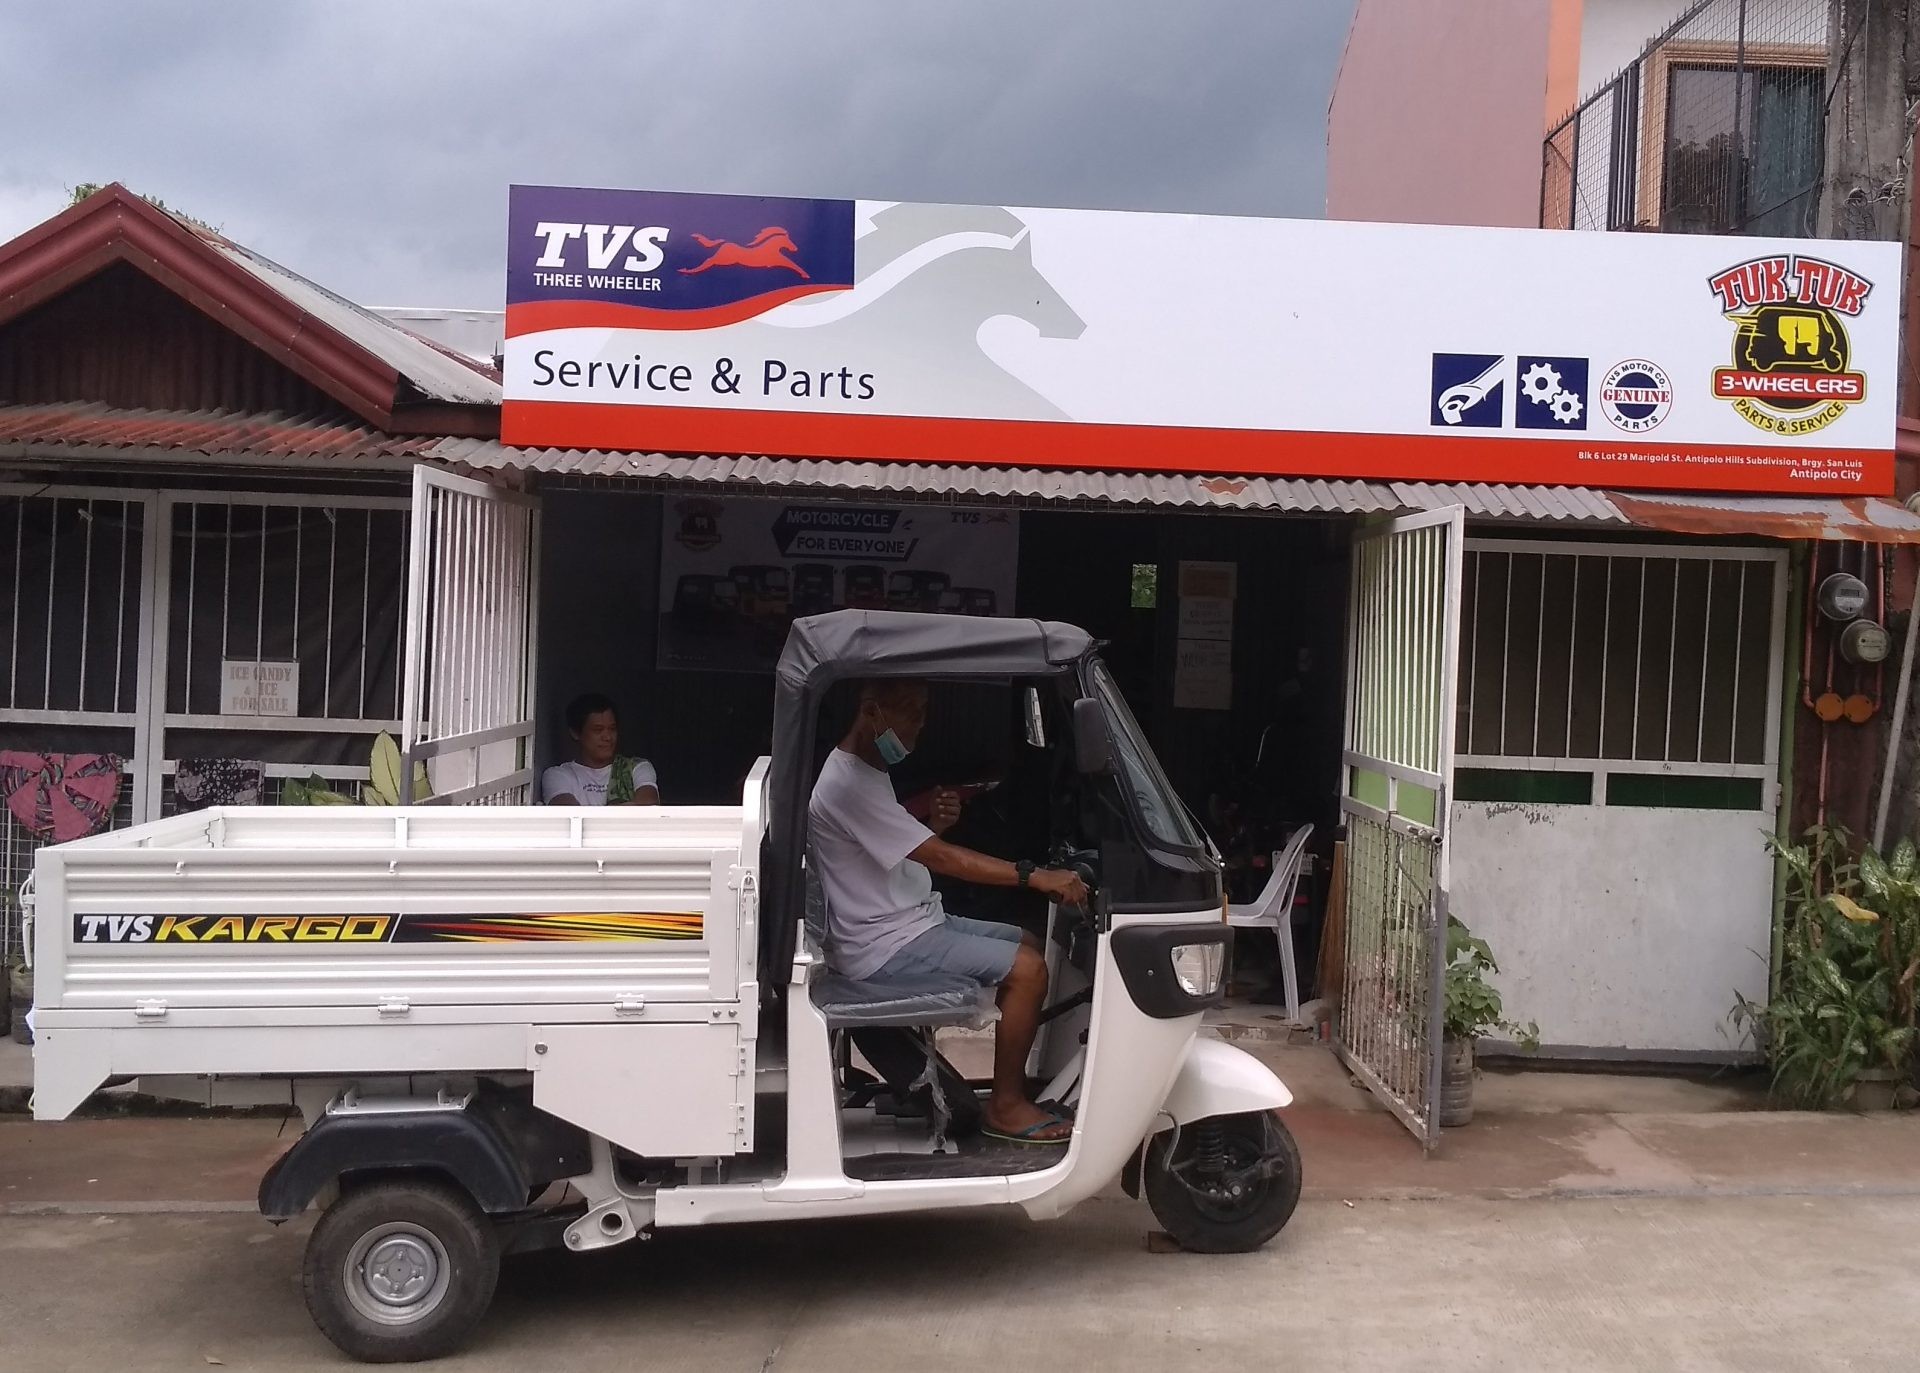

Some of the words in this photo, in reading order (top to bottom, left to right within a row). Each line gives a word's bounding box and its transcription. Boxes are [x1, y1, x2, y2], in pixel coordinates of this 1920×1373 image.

[533, 221, 670, 272] TVS
[533, 272, 583, 288] THREE
[587, 275, 662, 291] WHEELER
[1712, 258, 1787, 308] TUK
[1795, 259, 1869, 313] TUK
[533, 350, 692, 391] Service
[710, 357, 741, 394] &
[762, 359, 875, 400] Parts
[1606, 370, 1621, 386] TVS
[1621, 363, 1654, 374] MOTOR
[1654, 372, 1666, 388] CO.
[1721, 375, 1858, 394] 3-WHEELERS
[1603, 389, 1670, 403] GENUINE
[1614, 415, 1658, 429] PARTS
[1736, 398, 1774, 429] PARTS
[1776, 420, 1787, 433] &
[1790, 401, 1844, 433] SERVICE
[1578, 451, 1592, 460] Blk
[1593, 452, 1600, 460] 6
[1601, 452, 1616, 461] Lot
[1617, 452, 1628, 461] 29
[1629, 453, 1670, 464] Marigold
[1671, 455, 1683, 463] St.
[1685, 455, 1723, 465] Antipolo
[1725, 456, 1745, 464] Hills
[1746, 456, 1800, 467] Subdivision,
[1801, 458, 1825, 469] Brgy.
[1826, 459, 1843, 468] San
[1844, 459, 1863, 468] Luis
[1789, 468, 1839, 481] Antipolo
[1840, 469, 1862, 482] City
[786, 510, 889, 529] MOTORCYCLE
[951, 511, 981, 524] TVS
[796, 536, 825, 552] FOR
[828, 539, 905, 555] EVERYONE
[81, 915, 154, 942] TVS
[155, 916, 391, 941] KARGO
